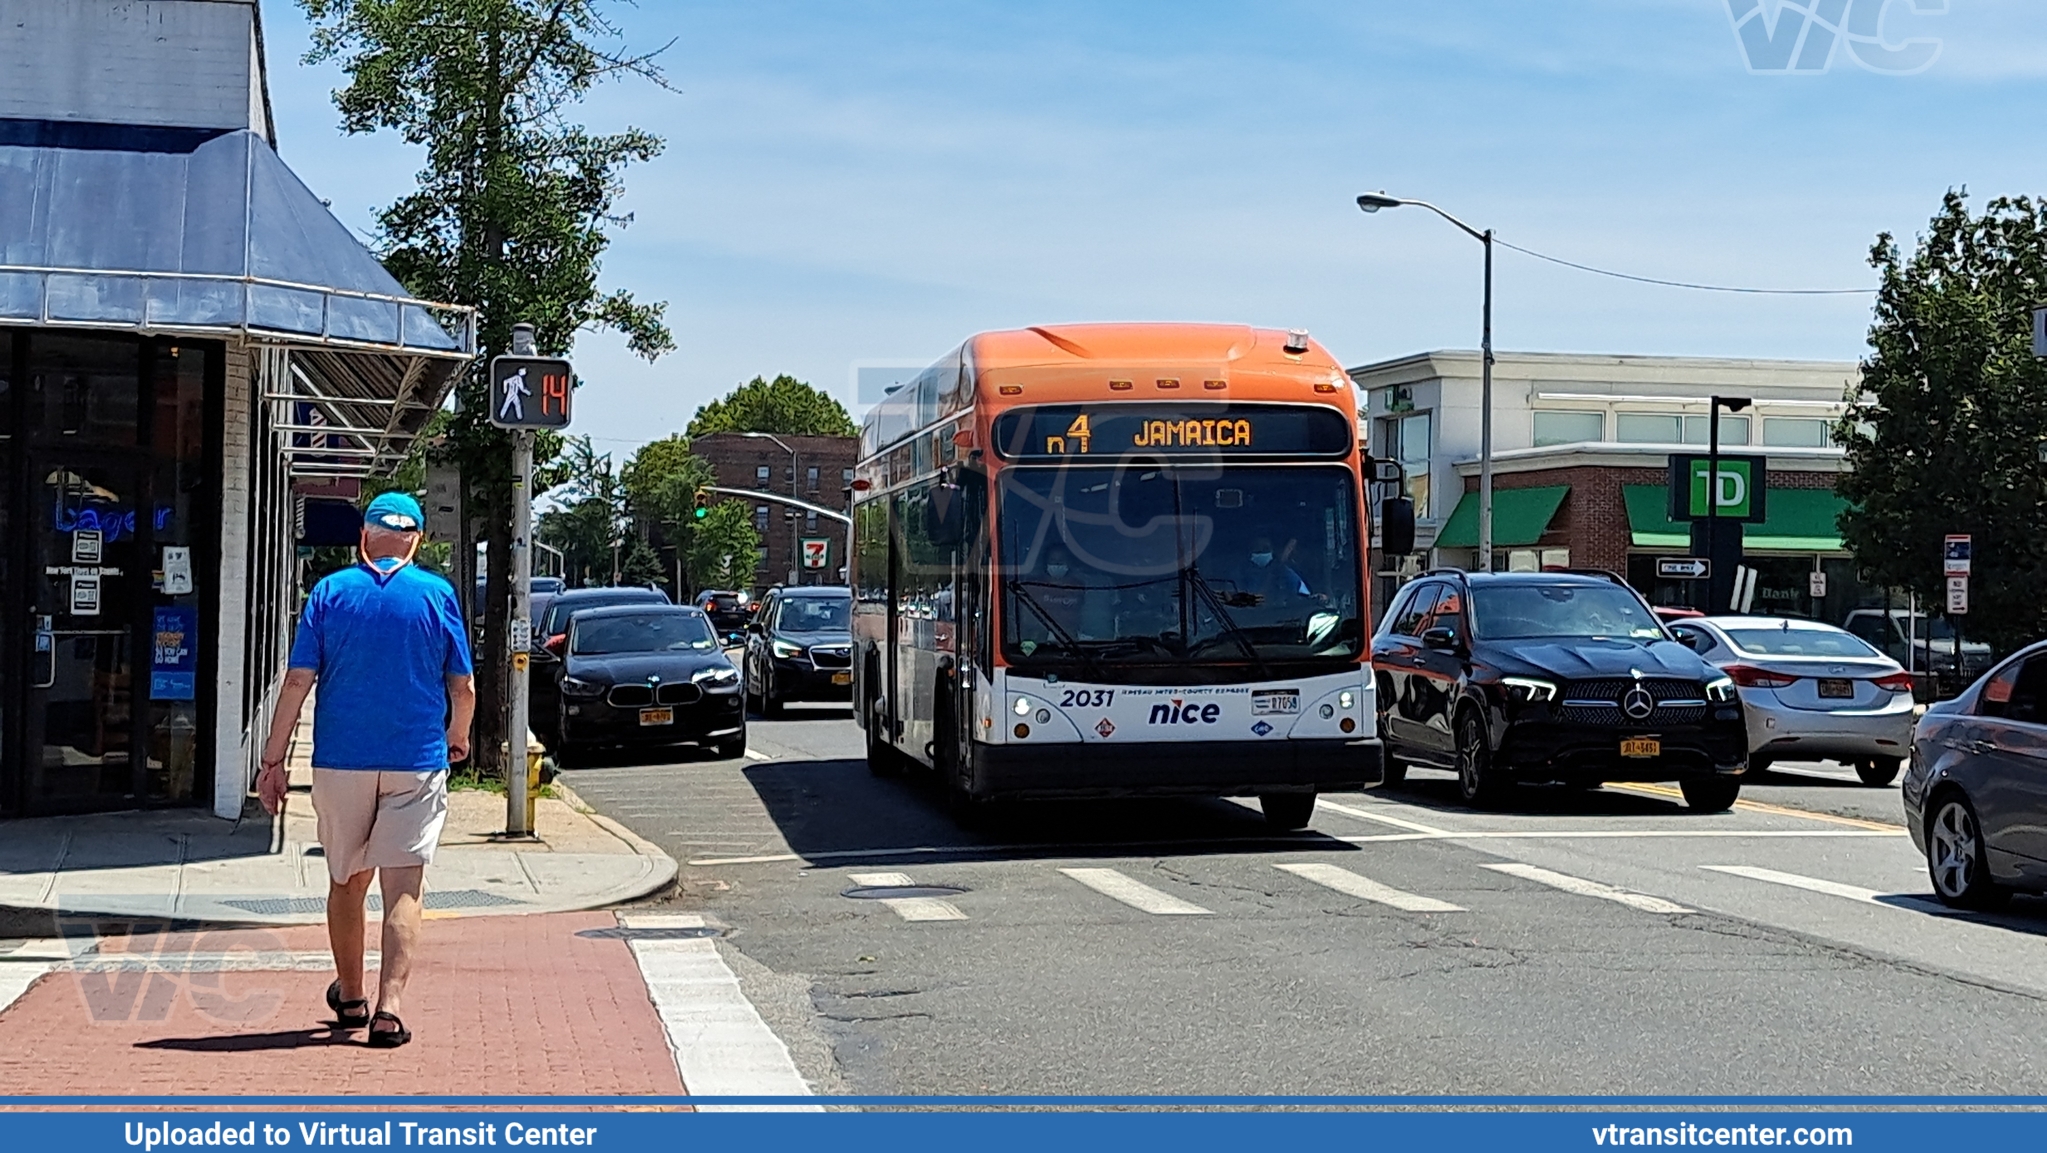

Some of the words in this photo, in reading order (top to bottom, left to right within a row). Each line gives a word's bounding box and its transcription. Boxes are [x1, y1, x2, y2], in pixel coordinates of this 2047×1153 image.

[541, 374, 566, 416] 14
[1047, 414, 1092, 453] n4
[1134, 420, 1251, 446] JAMAICA
[1696, 469, 1746, 506] TD
[1060, 690, 1115, 708] 2031
[1149, 699, 1220, 724] nice
